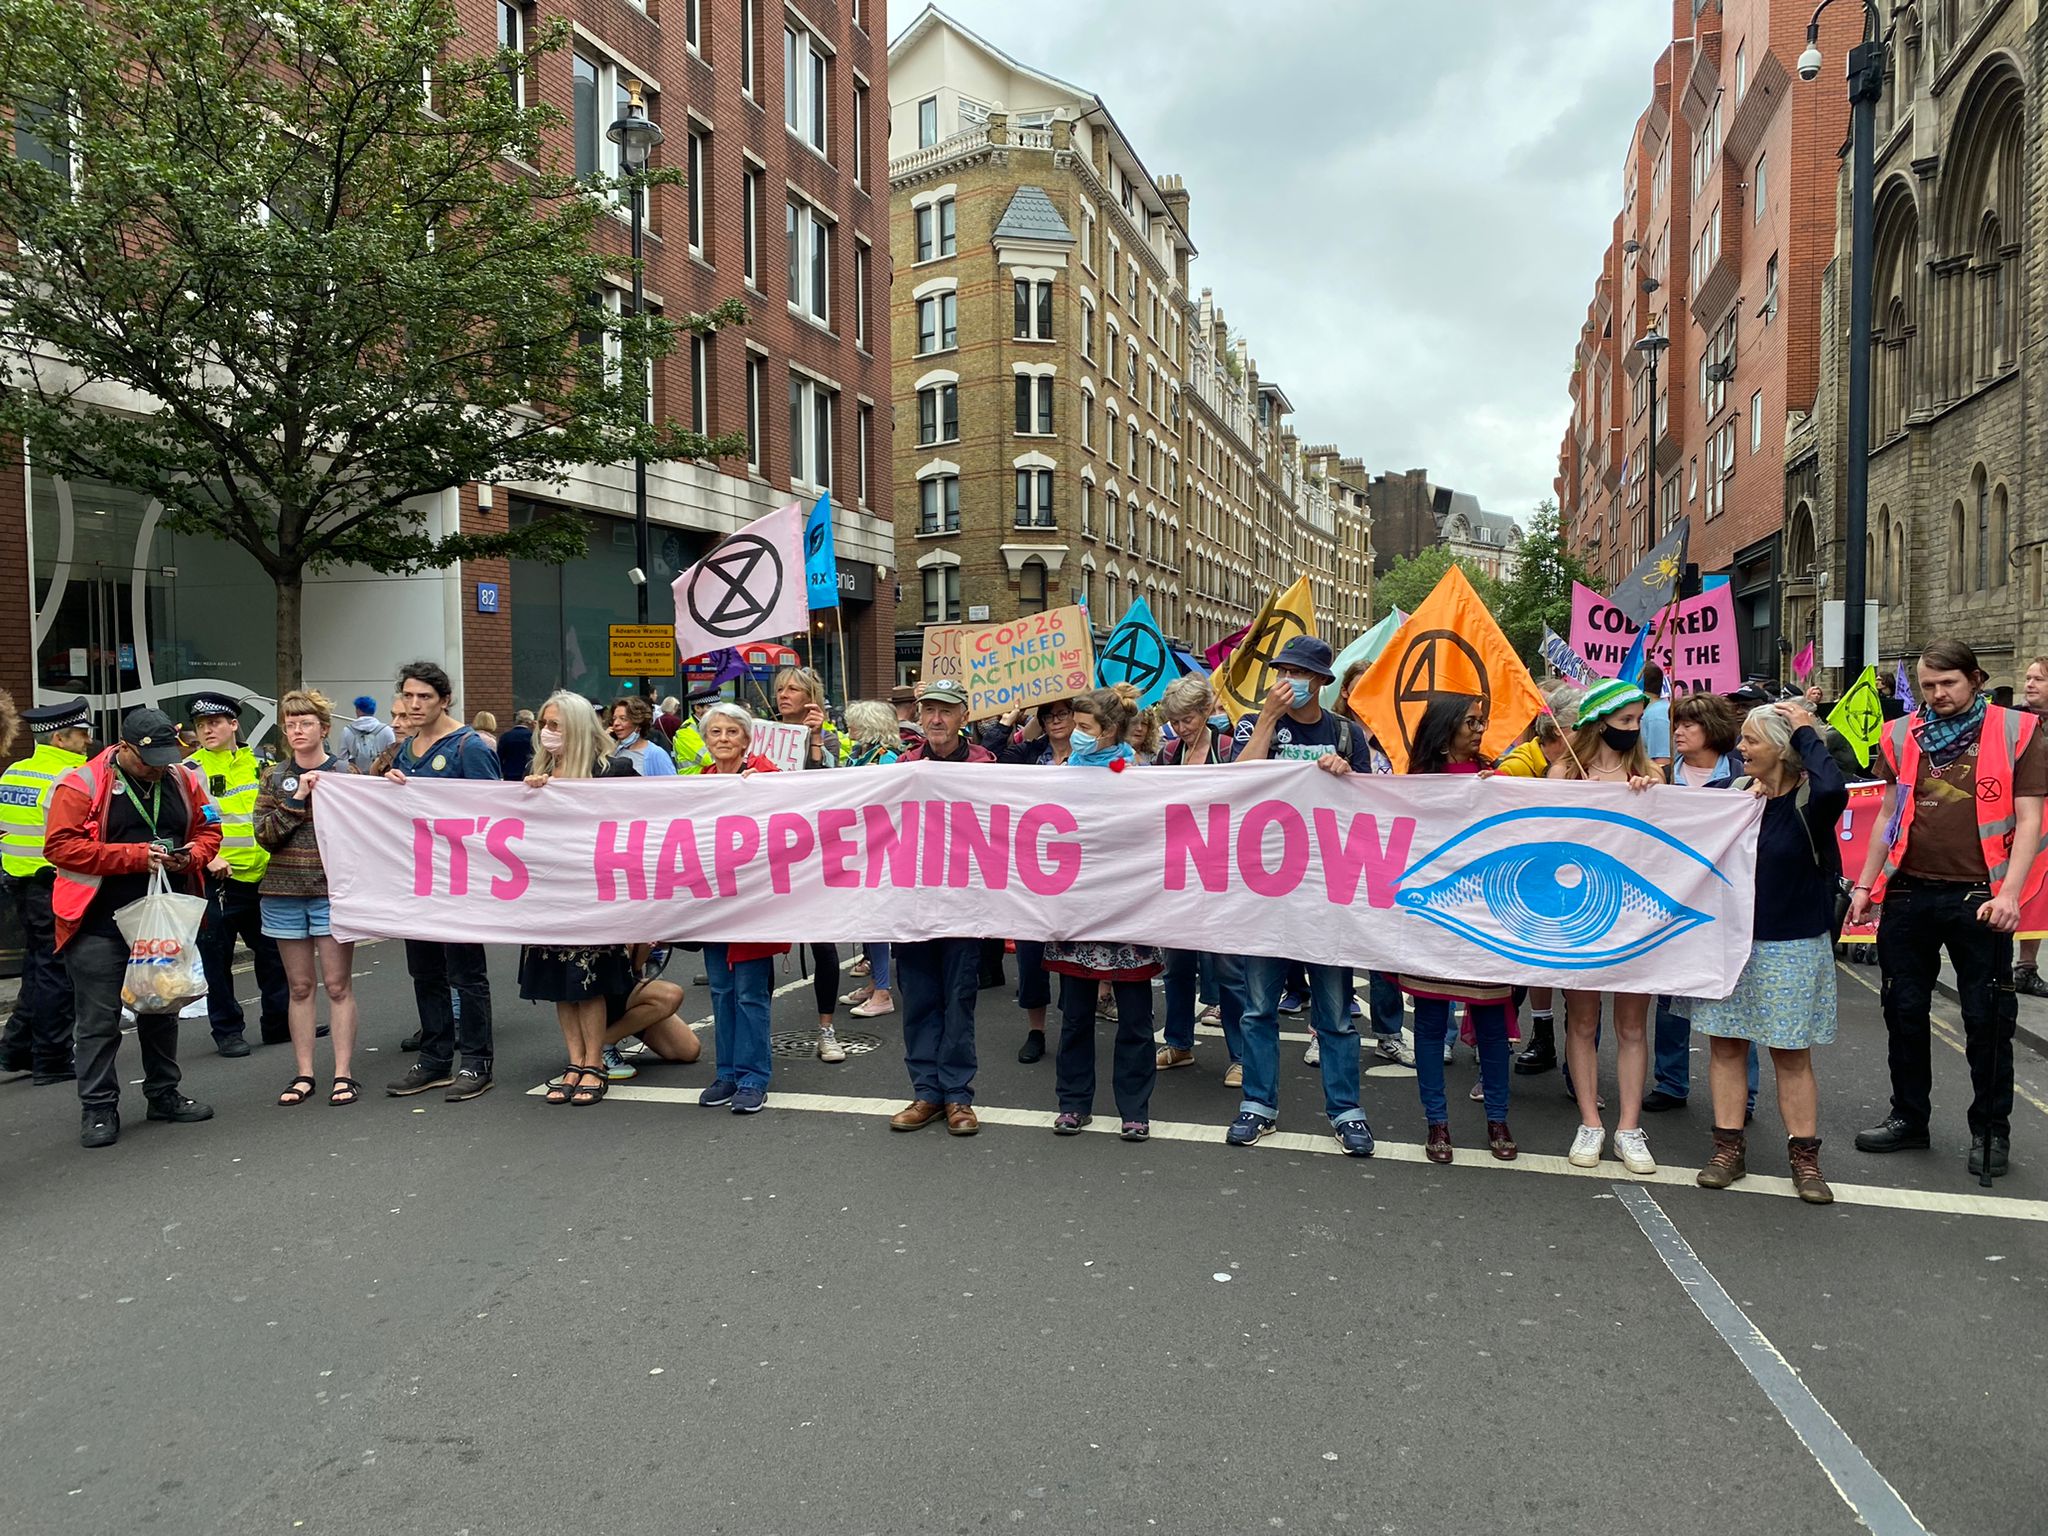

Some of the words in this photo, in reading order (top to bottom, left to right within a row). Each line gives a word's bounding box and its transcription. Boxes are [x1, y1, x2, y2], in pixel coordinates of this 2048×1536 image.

[481, 589, 495, 606] 82
[975, 622, 1028, 652] COP
[1034, 610, 1063, 634] 26
[1669, 605, 1718, 635] RED
[928, 629, 975, 656] STO
[970, 651, 999, 670] WE
[1011, 632, 1066, 659] NEED
[1584, 641, 1672, 667] WHEE'S
[1685, 645, 1720, 665] THE
[970, 651, 1055, 689] ACTION
[1060, 649, 1082, 662] NOT
[972, 674, 1064, 711] PROMISES
[412, 816, 529, 900] IT'S
[596, 800, 1082, 900] HAPPENING
[1164, 799, 1417, 909] NOW
[131, 939, 181, 956] SCO
